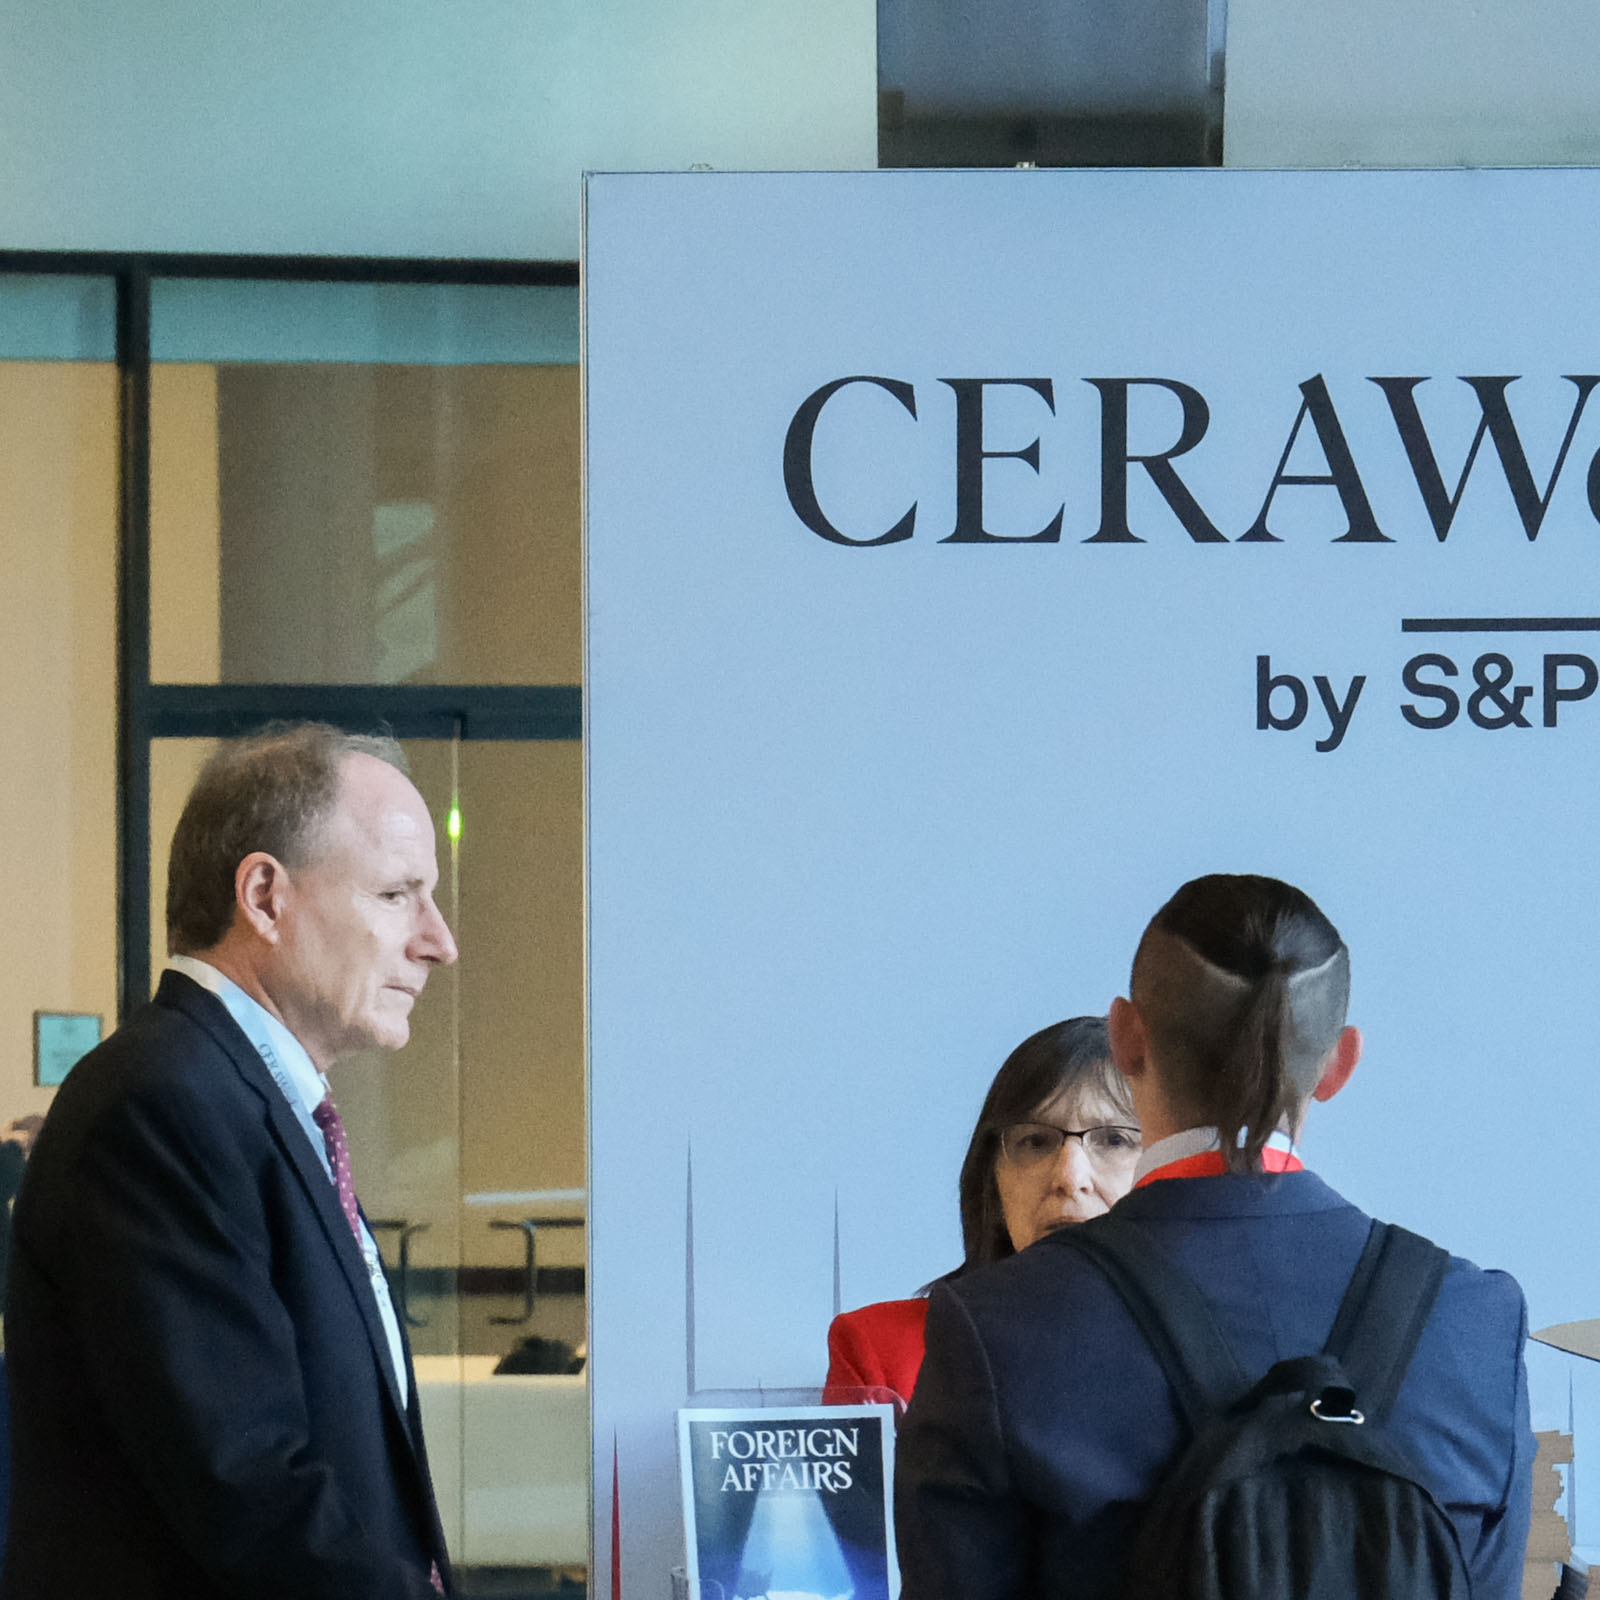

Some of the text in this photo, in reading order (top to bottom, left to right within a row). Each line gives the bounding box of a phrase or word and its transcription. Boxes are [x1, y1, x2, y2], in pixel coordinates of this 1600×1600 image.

[1257, 655, 1366, 752] by
[1401, 653, 1598, 729] S&P
[258, 1043, 299, 1105] CERAW
[710, 1428, 859, 1461] FOREIGN
[720, 1461, 853, 1493] AFFAIRS
